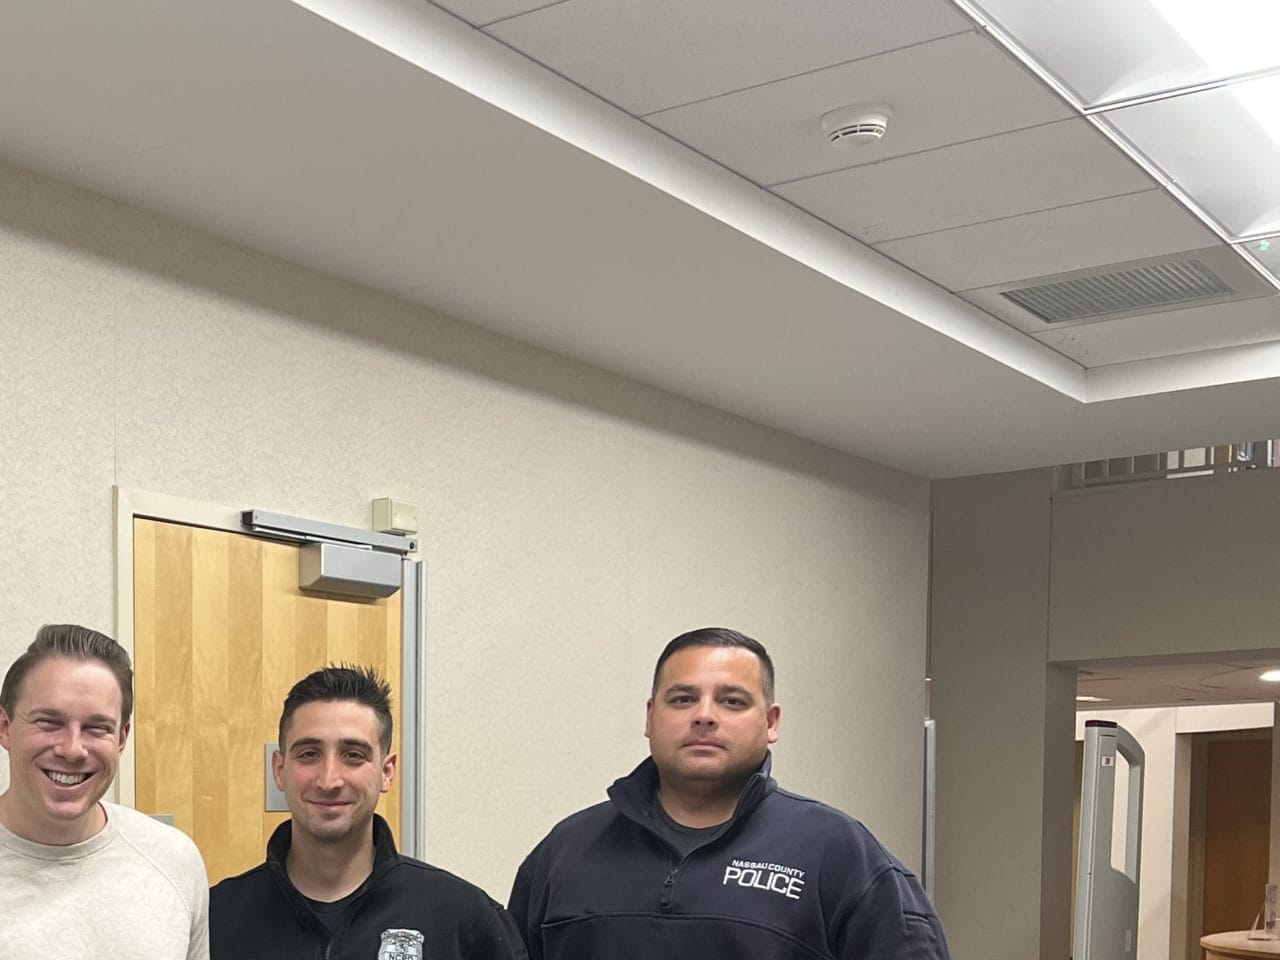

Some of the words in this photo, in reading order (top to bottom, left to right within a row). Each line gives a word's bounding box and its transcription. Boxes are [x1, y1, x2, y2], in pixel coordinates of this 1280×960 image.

[732, 859, 768, 870] NASSAU
[768, 863, 805, 878] COUNTY
[723, 866, 805, 899] POLICE
